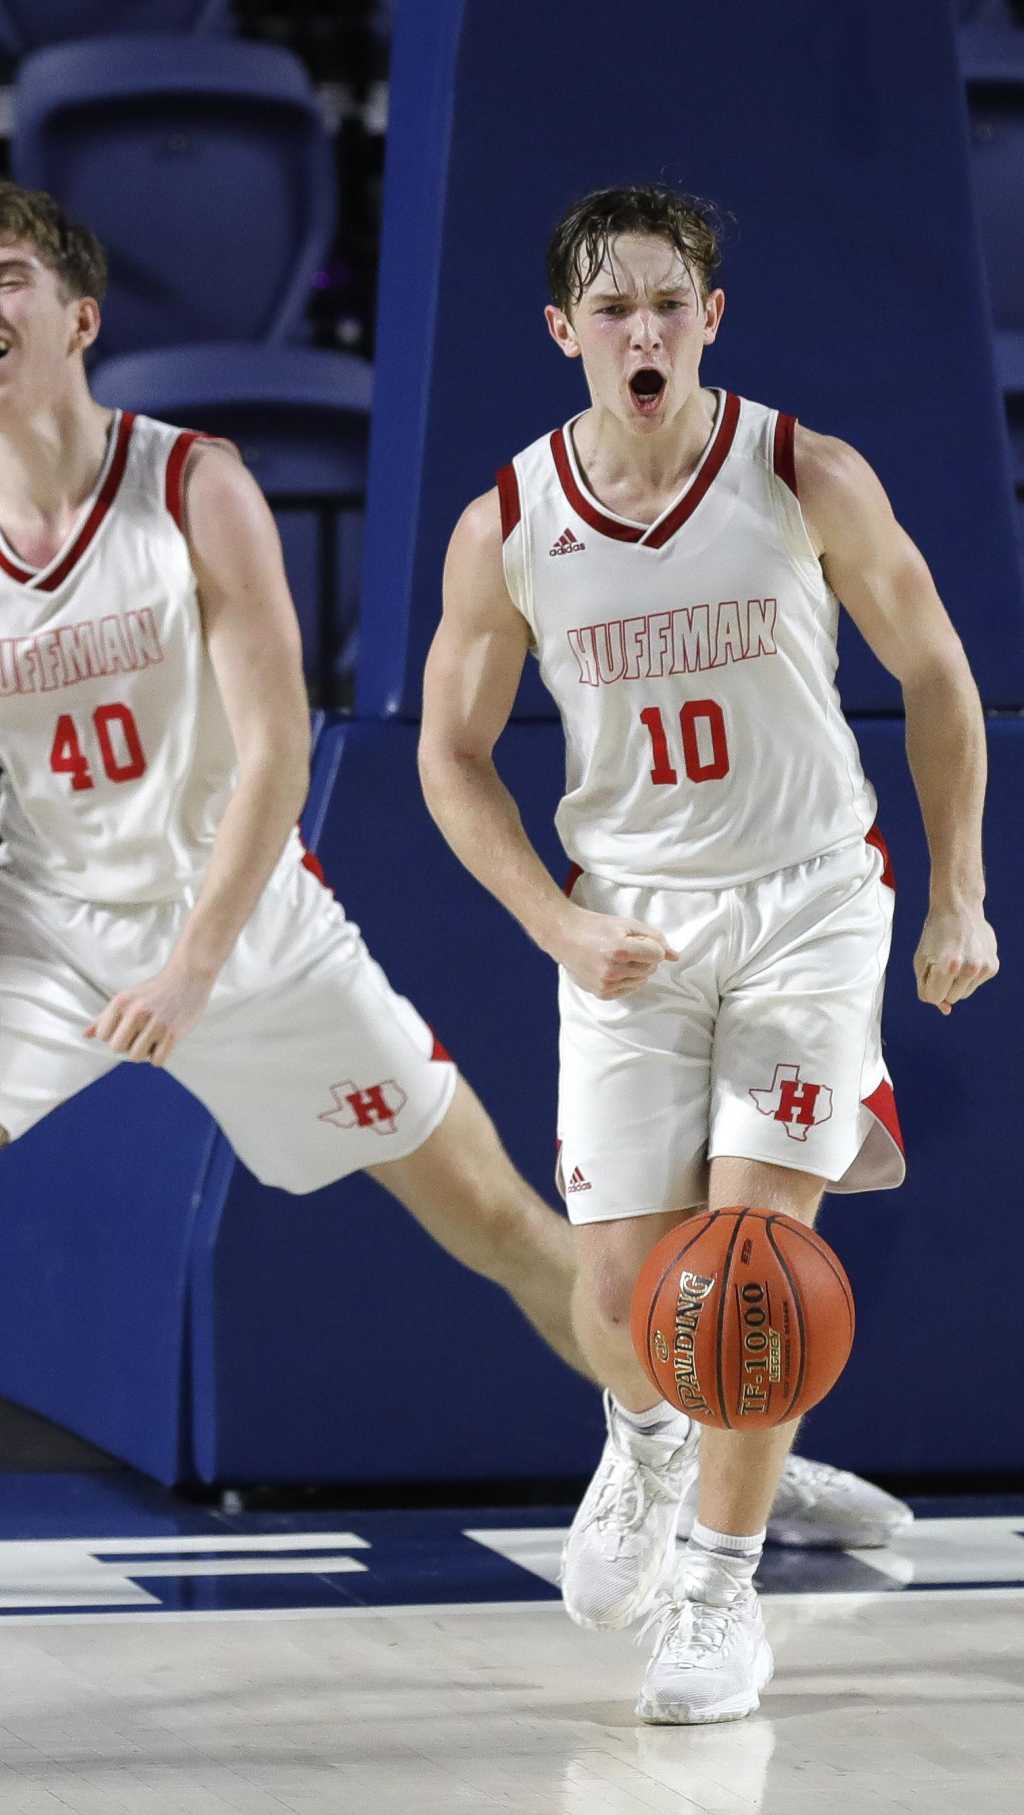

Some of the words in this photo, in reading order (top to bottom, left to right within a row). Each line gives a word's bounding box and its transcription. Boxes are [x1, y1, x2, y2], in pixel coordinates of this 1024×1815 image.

[549, 542, 586, 557] adidas
[568, 599, 777, 687] HUFFMAN
[50, 702, 147, 790] 40
[640, 699, 729, 785] 10
[345, 1085, 395, 1127] H
[774, 1080, 821, 1125] H
[740, 1282, 768, 1416] TF-1000
